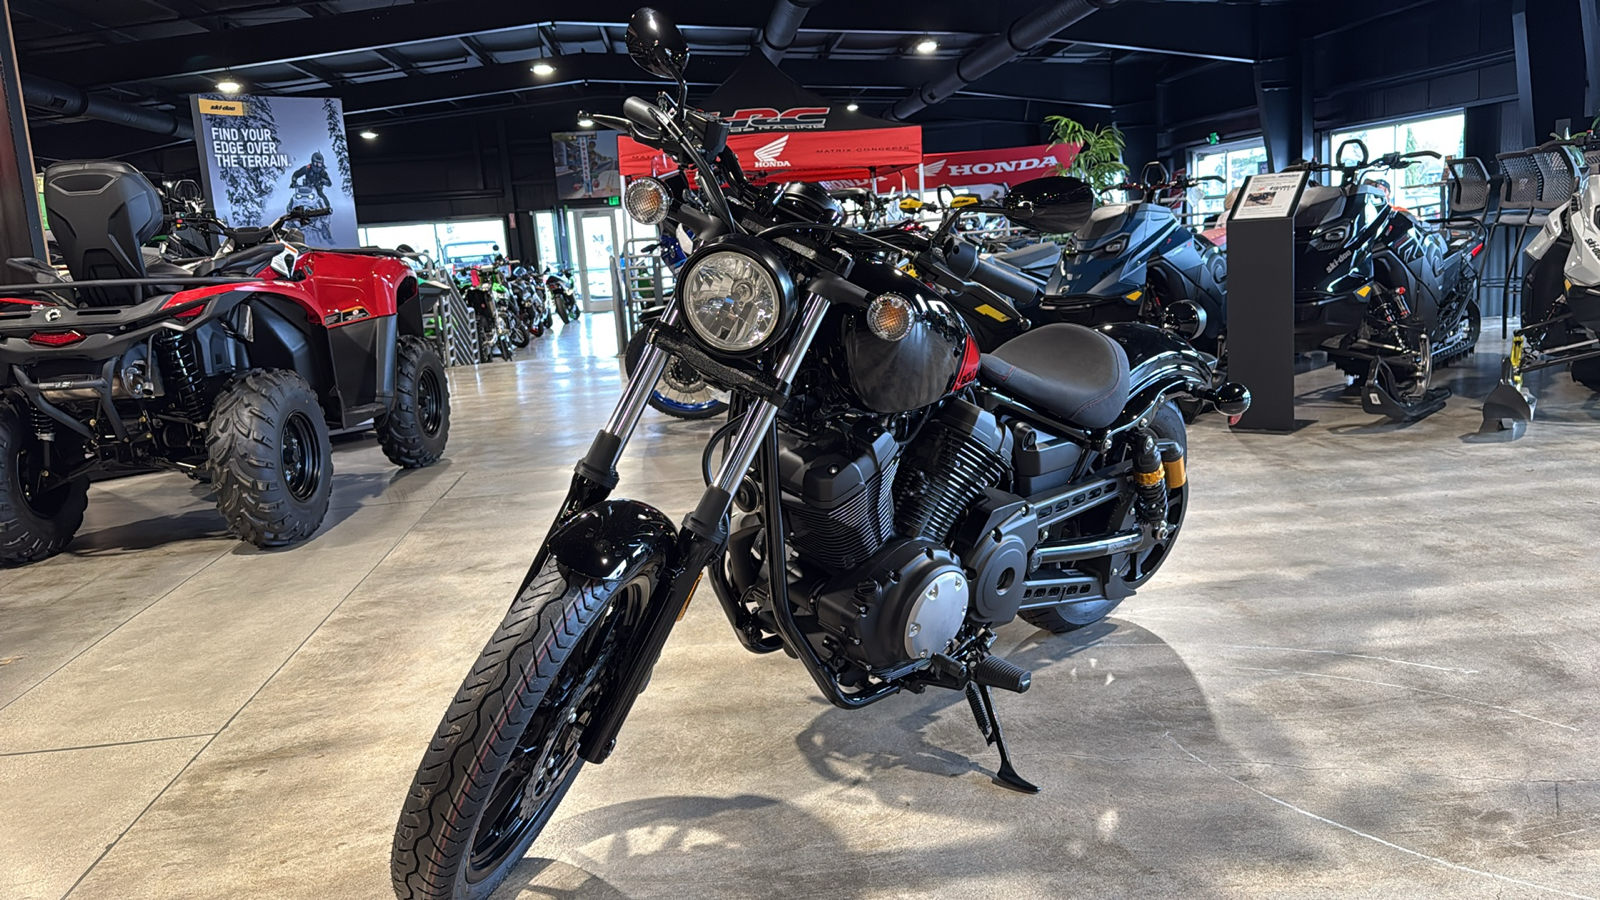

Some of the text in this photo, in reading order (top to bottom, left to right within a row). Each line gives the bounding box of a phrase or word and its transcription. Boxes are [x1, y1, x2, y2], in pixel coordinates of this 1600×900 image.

[211, 127, 272, 141] FIND YOUR
[213, 141, 277, 154] EDGE OVER
[214, 154, 292, 168] THE TERRAIN.
[754, 160, 791, 168] HONDA
[948, 155, 1058, 176] HONDA
[1325, 250, 1352, 273] ski-doo
